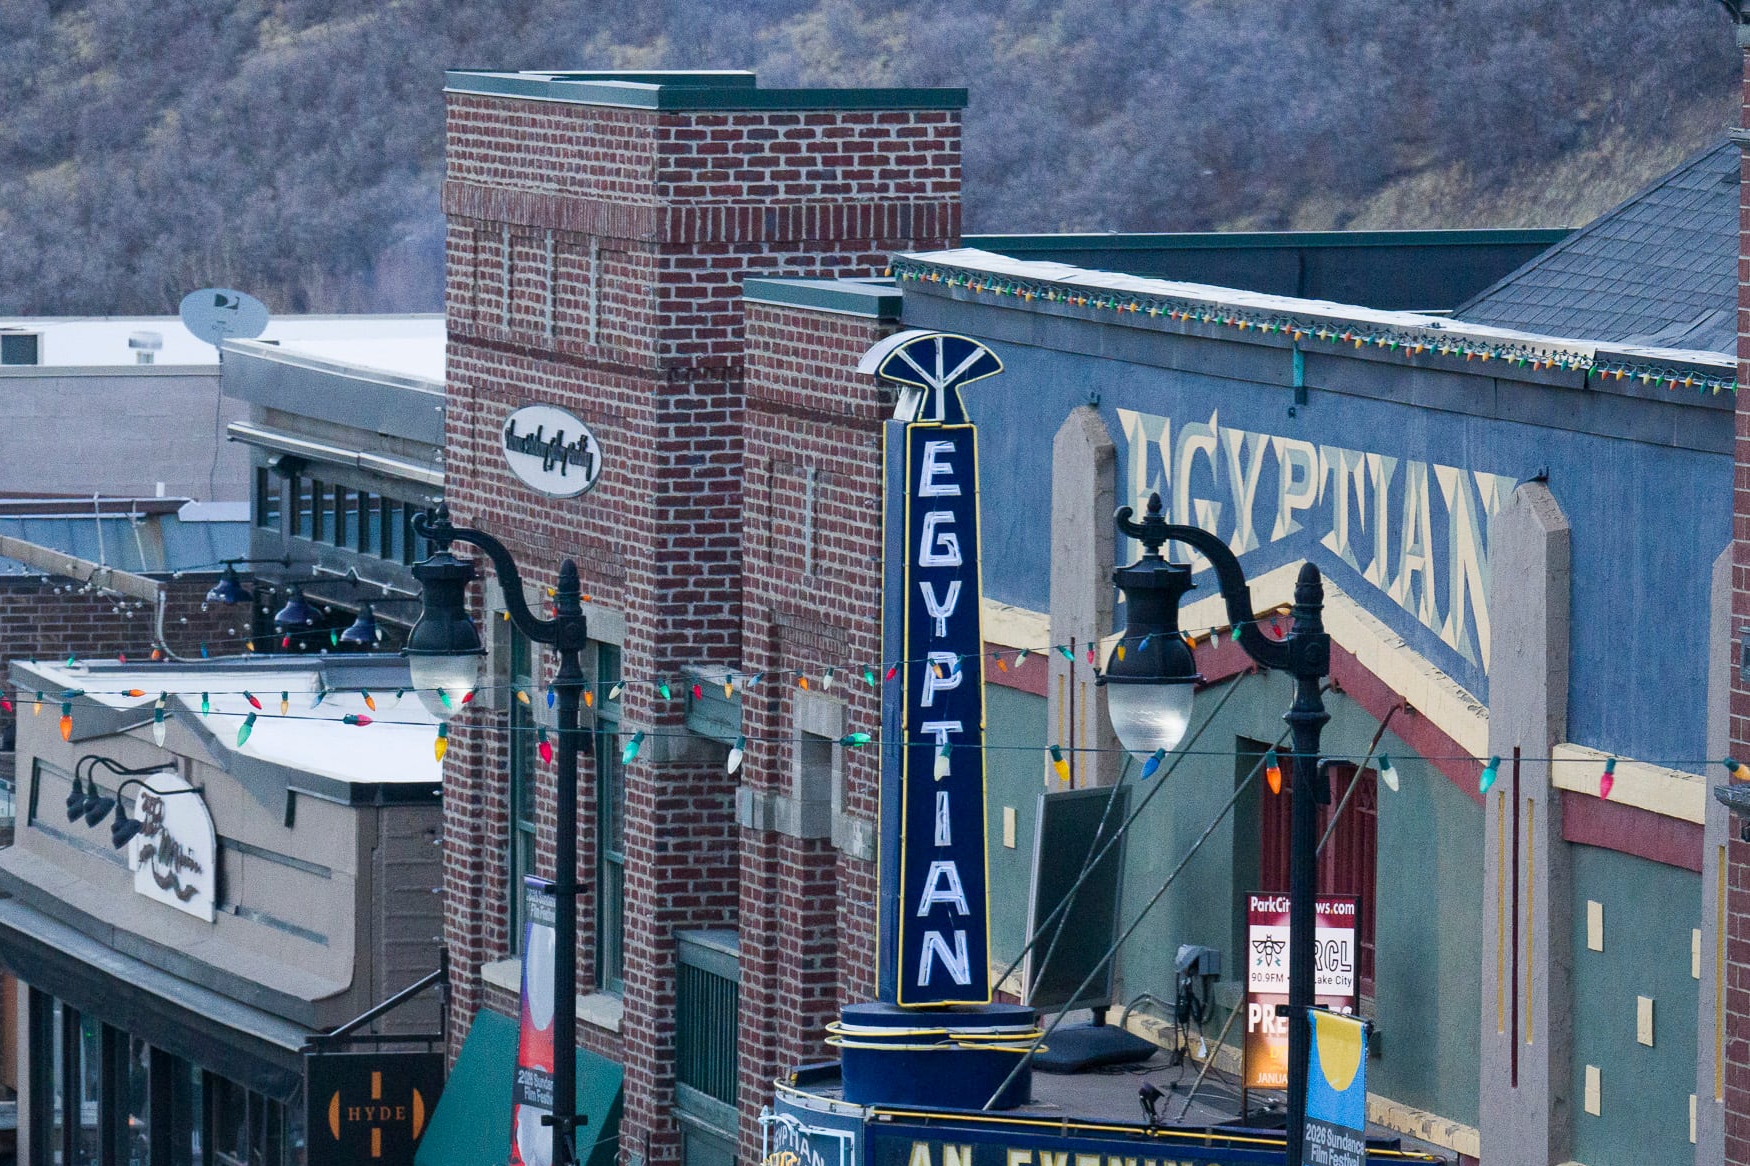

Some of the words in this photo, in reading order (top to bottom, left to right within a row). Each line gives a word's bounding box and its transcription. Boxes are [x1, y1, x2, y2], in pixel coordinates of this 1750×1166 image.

[917, 440, 970, 985] EGYPTIAN
[1315, 939, 1352, 972] RCL
[1251, 973, 1284, 983] 90.9FM
[1335, 976, 1352, 986] City
[348, 1106, 405, 1120] HYDE
[1306, 1123, 1326, 1145] 2026
[1327, 1128, 1364, 1156] Sundance
[1310, 1146, 1329, 1165] Film
